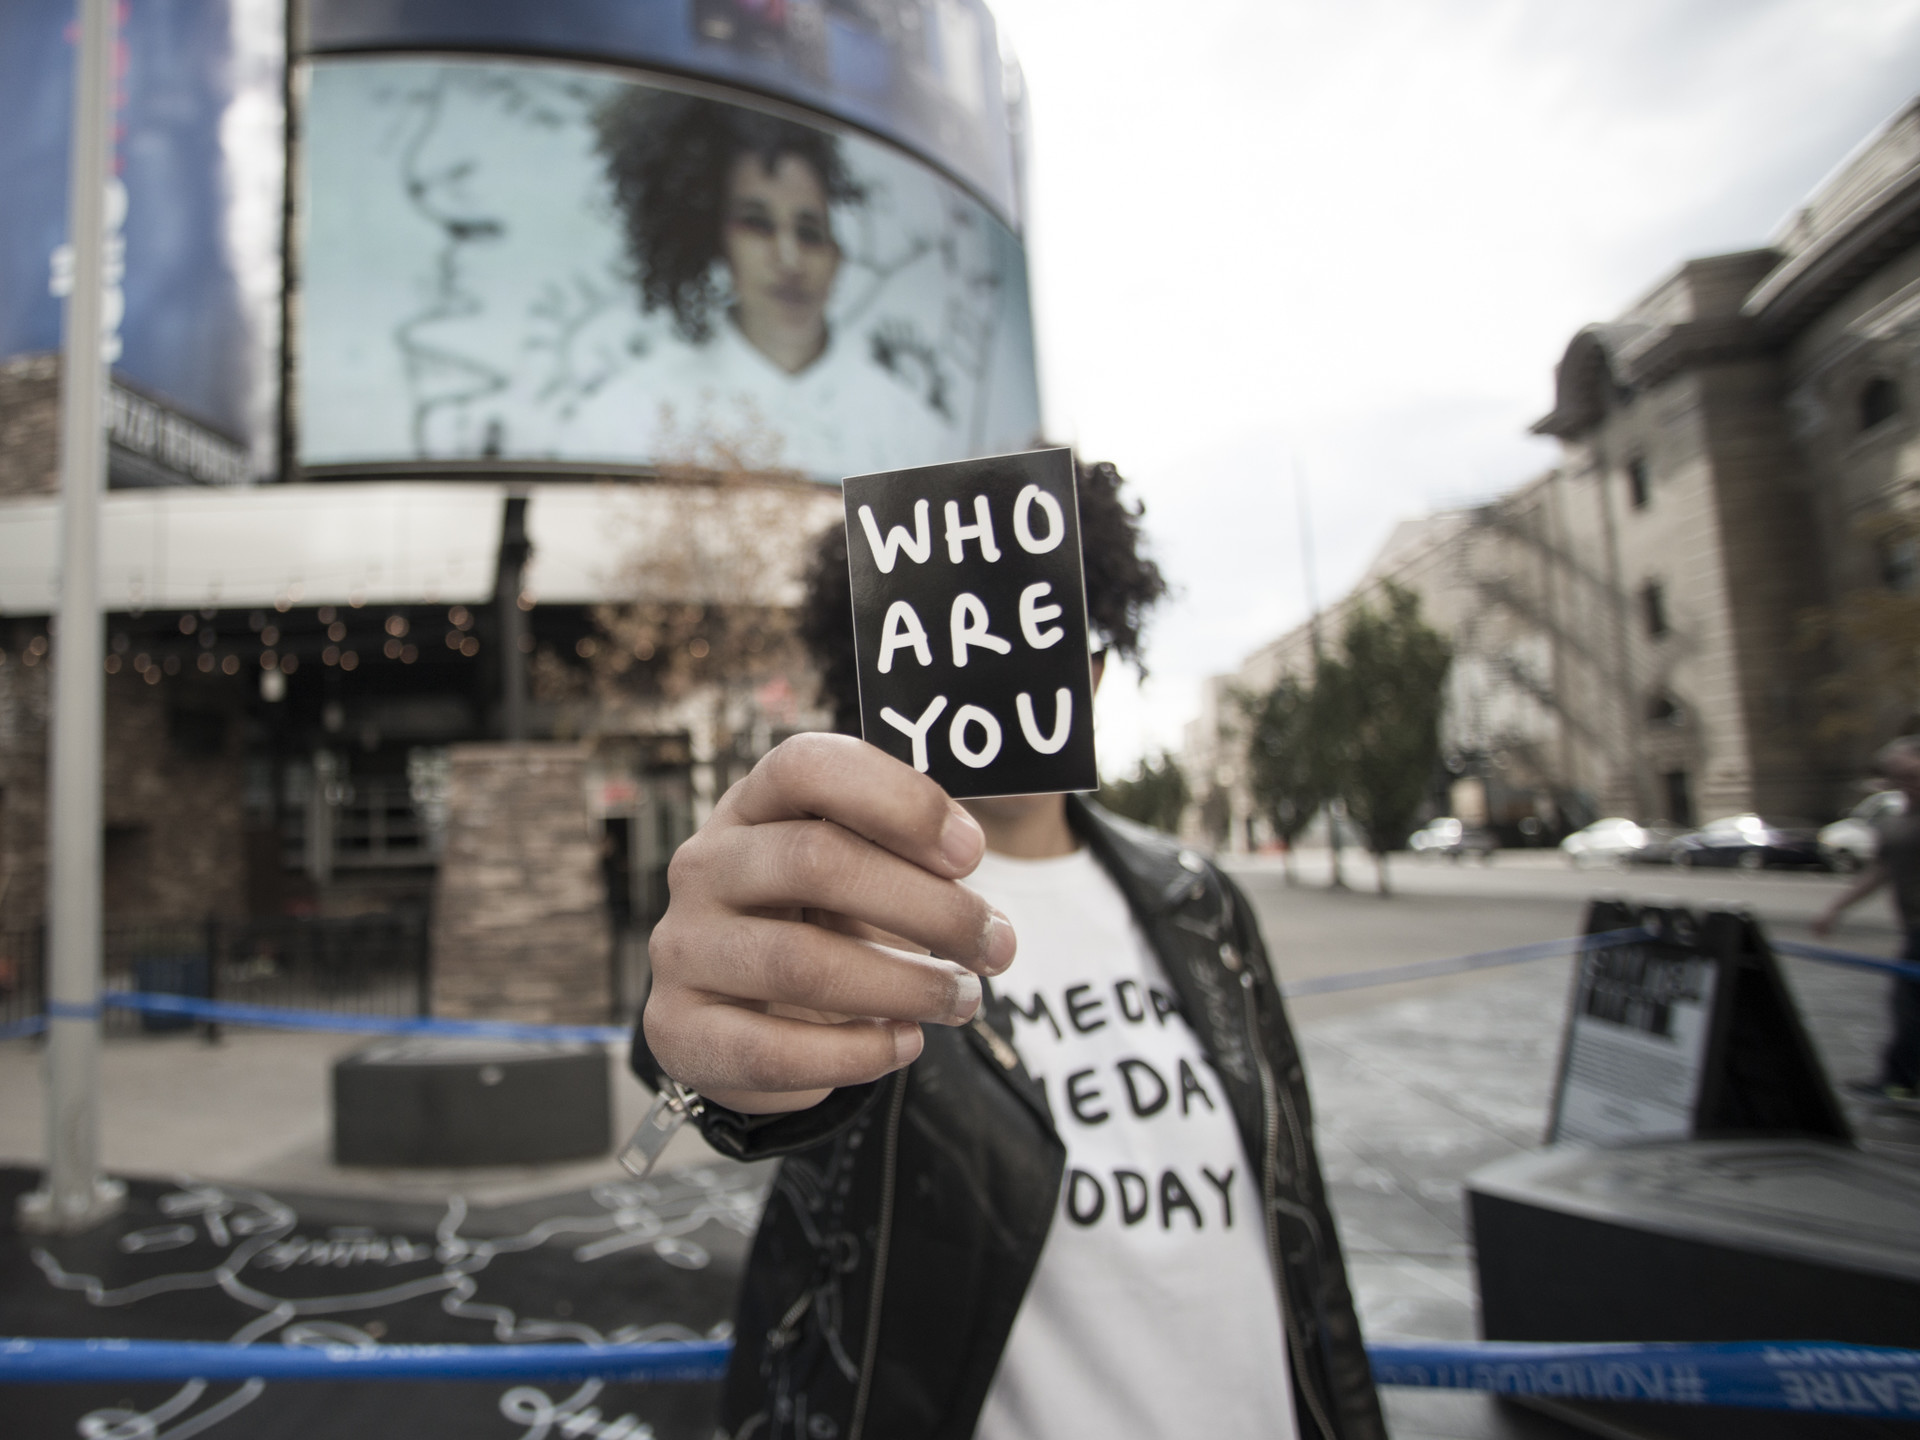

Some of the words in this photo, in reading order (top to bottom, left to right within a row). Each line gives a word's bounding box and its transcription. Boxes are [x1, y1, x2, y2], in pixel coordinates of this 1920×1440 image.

[858, 484, 1065, 574] WHO
[877, 582, 1064, 673] ARE
[880, 687, 1073, 773] YOU
[1036, 1057, 1214, 1126] EDA
